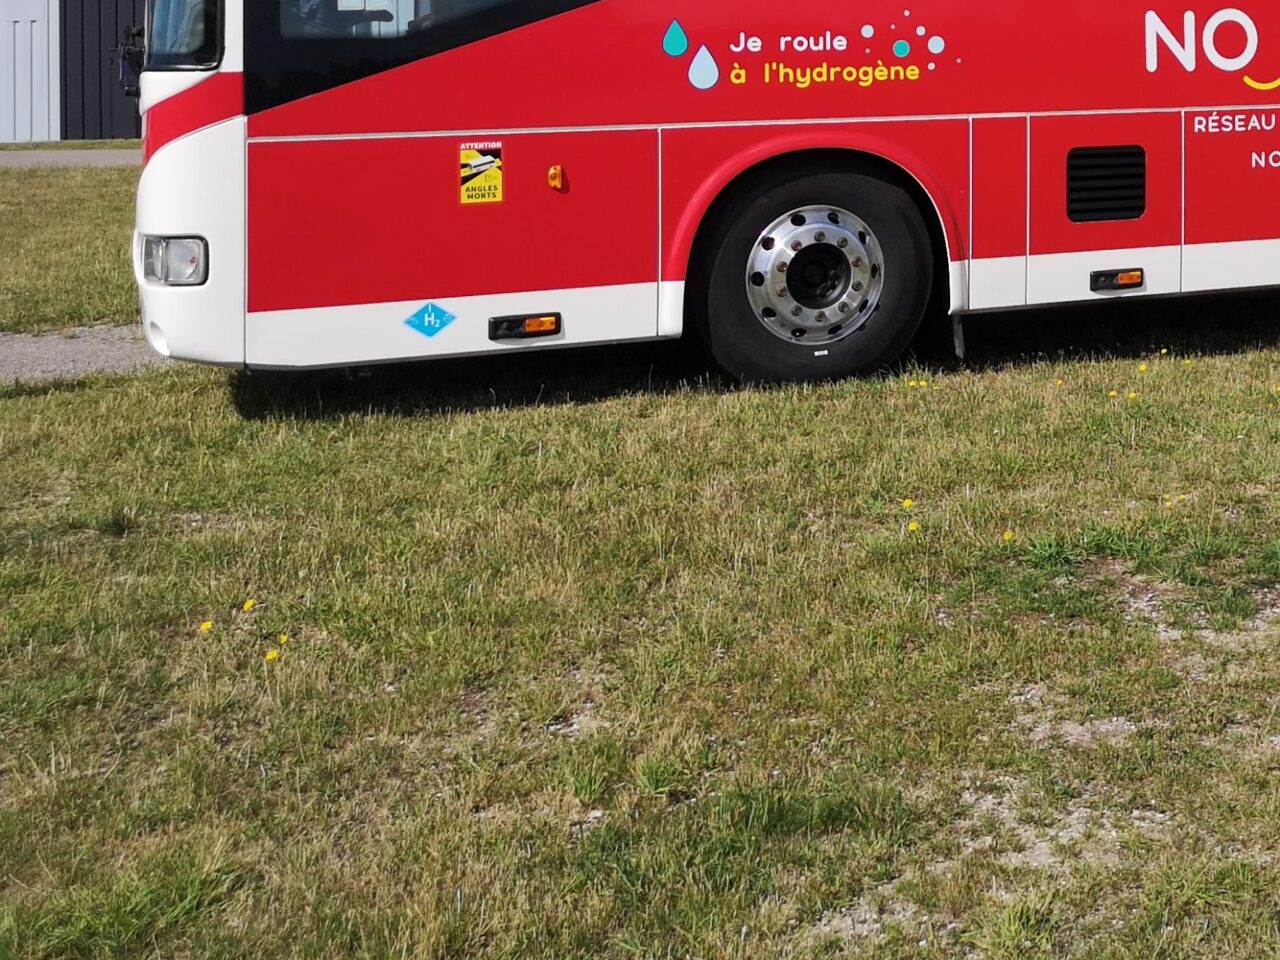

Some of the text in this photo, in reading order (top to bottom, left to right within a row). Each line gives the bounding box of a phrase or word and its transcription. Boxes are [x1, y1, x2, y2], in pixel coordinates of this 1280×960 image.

[729, 30, 848, 53] Je roule
[729, 59, 920, 88] à l'hydrogène
[1193, 111, 1276, 133] RÉSEAU
[460, 141, 502, 150] ATTENTION
[465, 185, 498, 193] ANGLES
